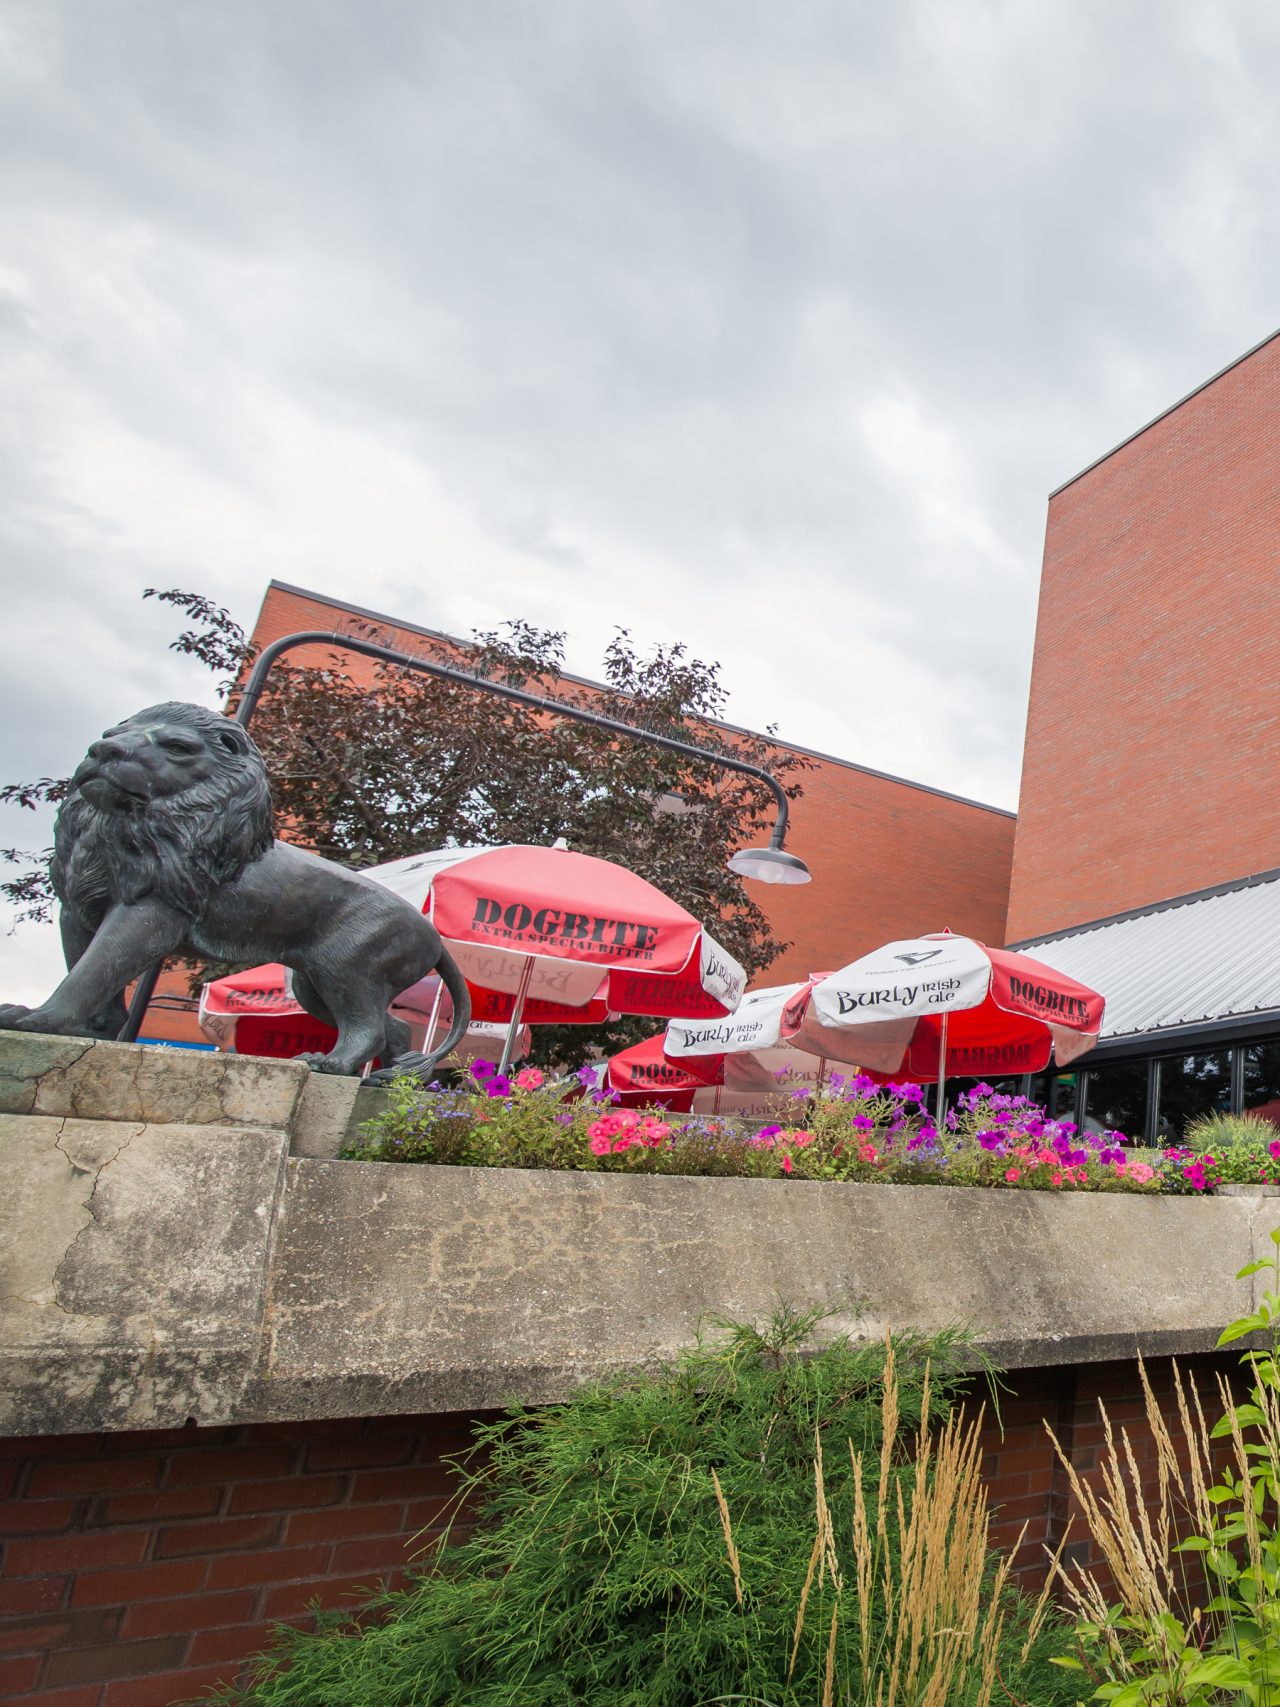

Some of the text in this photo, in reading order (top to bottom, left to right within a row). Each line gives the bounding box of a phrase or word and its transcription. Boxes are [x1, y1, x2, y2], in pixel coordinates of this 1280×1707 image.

[471, 921, 654, 961] EXTRA SPECIAL BITTER
[472, 897, 659, 951] DOGBITE
[928, 991, 955, 1003] ale
[1010, 976, 1089, 1018] DOGBITE
